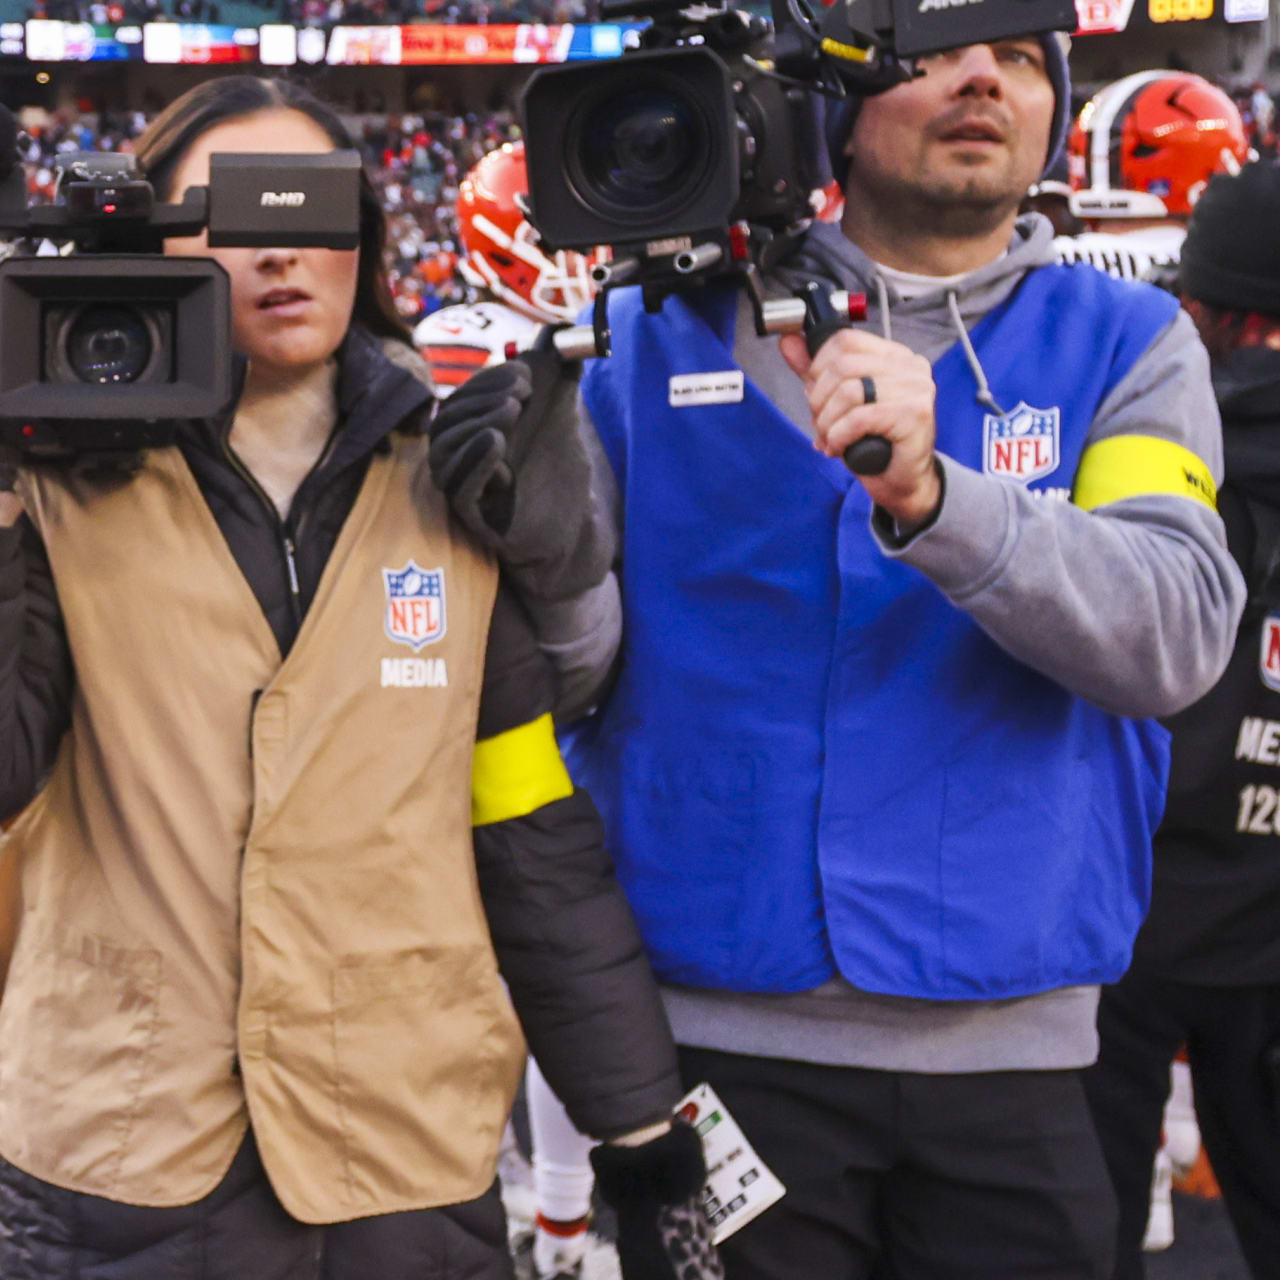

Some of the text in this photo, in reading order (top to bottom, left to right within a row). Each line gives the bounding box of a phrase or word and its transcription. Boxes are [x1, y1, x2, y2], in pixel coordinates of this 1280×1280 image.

[993, 439, 1050, 473] NFL
[392, 598, 439, 637] NFL
[381, 657, 449, 688] MEDIA
